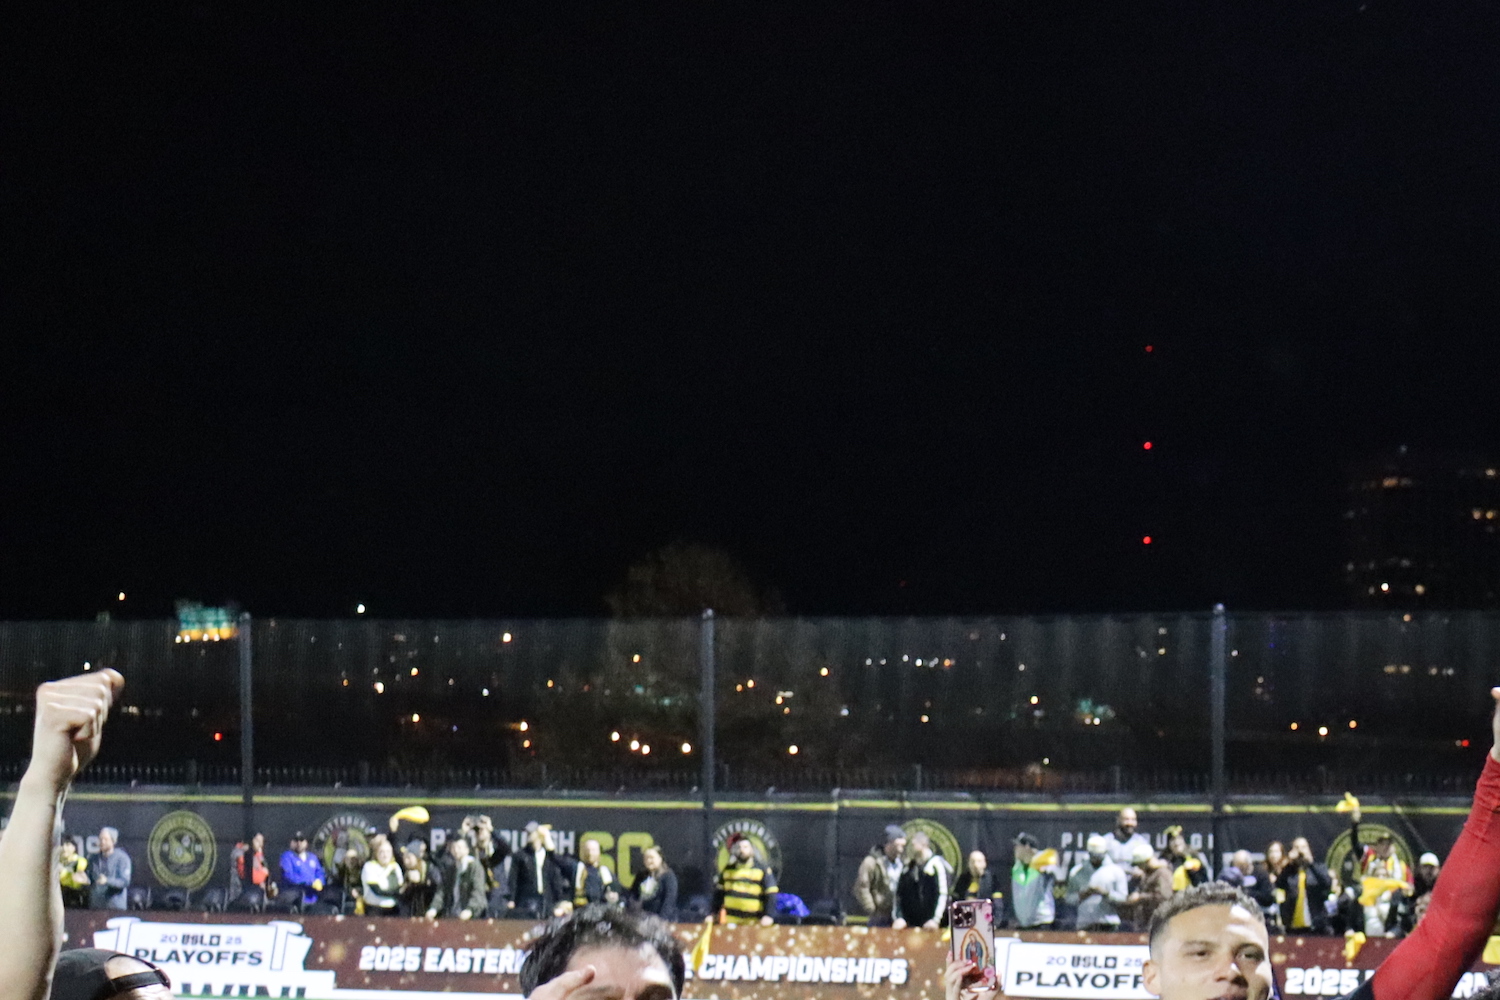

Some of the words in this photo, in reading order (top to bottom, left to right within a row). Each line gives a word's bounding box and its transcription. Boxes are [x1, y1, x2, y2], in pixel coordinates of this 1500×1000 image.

[135, 948, 263, 966] PLAYOFFS
[359, 945, 422, 971] 2025
[698, 954, 908, 984] CHAMPIONSHIPS
[1015, 971, 1145, 989] PLAYOFF
[1285, 967, 1360, 995] 2025
